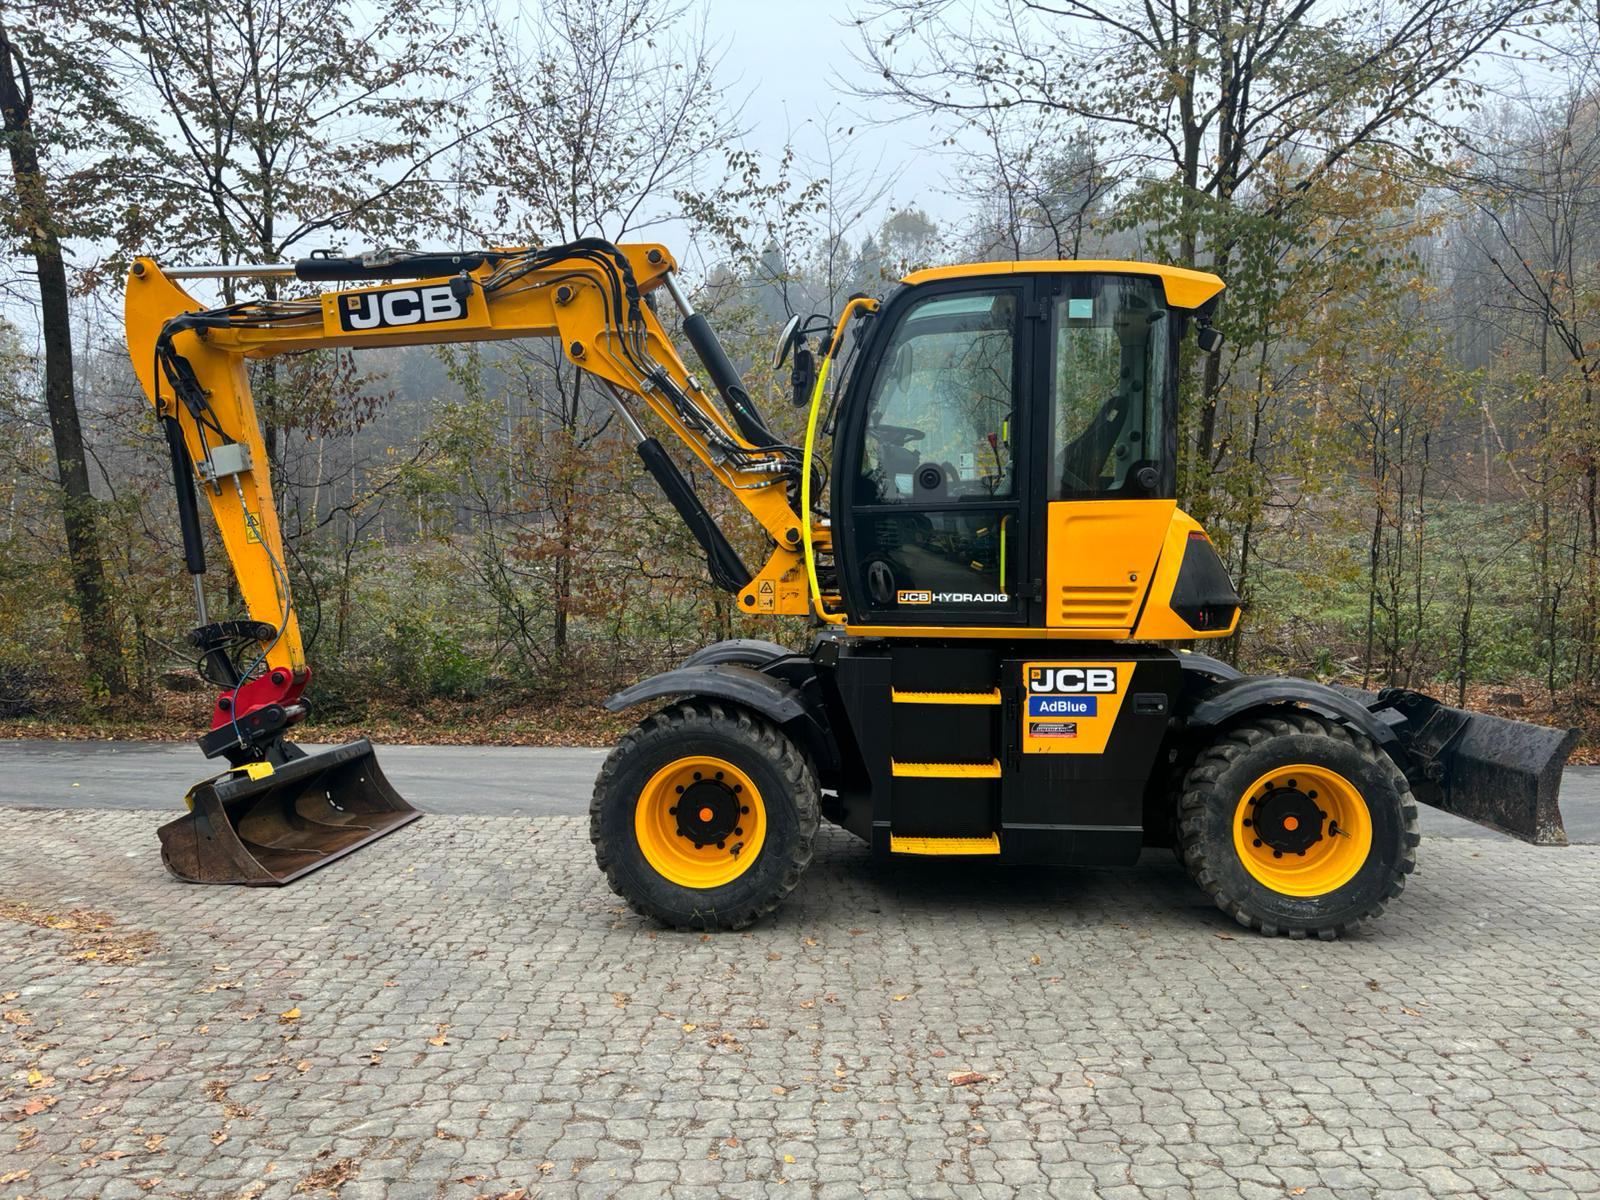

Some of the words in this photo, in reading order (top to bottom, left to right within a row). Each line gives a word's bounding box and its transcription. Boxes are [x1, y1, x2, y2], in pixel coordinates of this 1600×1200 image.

[349, 286, 461, 329] JCB
[900, 593, 929, 601] JCB
[932, 593, 1008, 602] HYDRADIG
[1031, 669, 1115, 692] JCB
[1039, 701, 1088, 712] AdBlue
